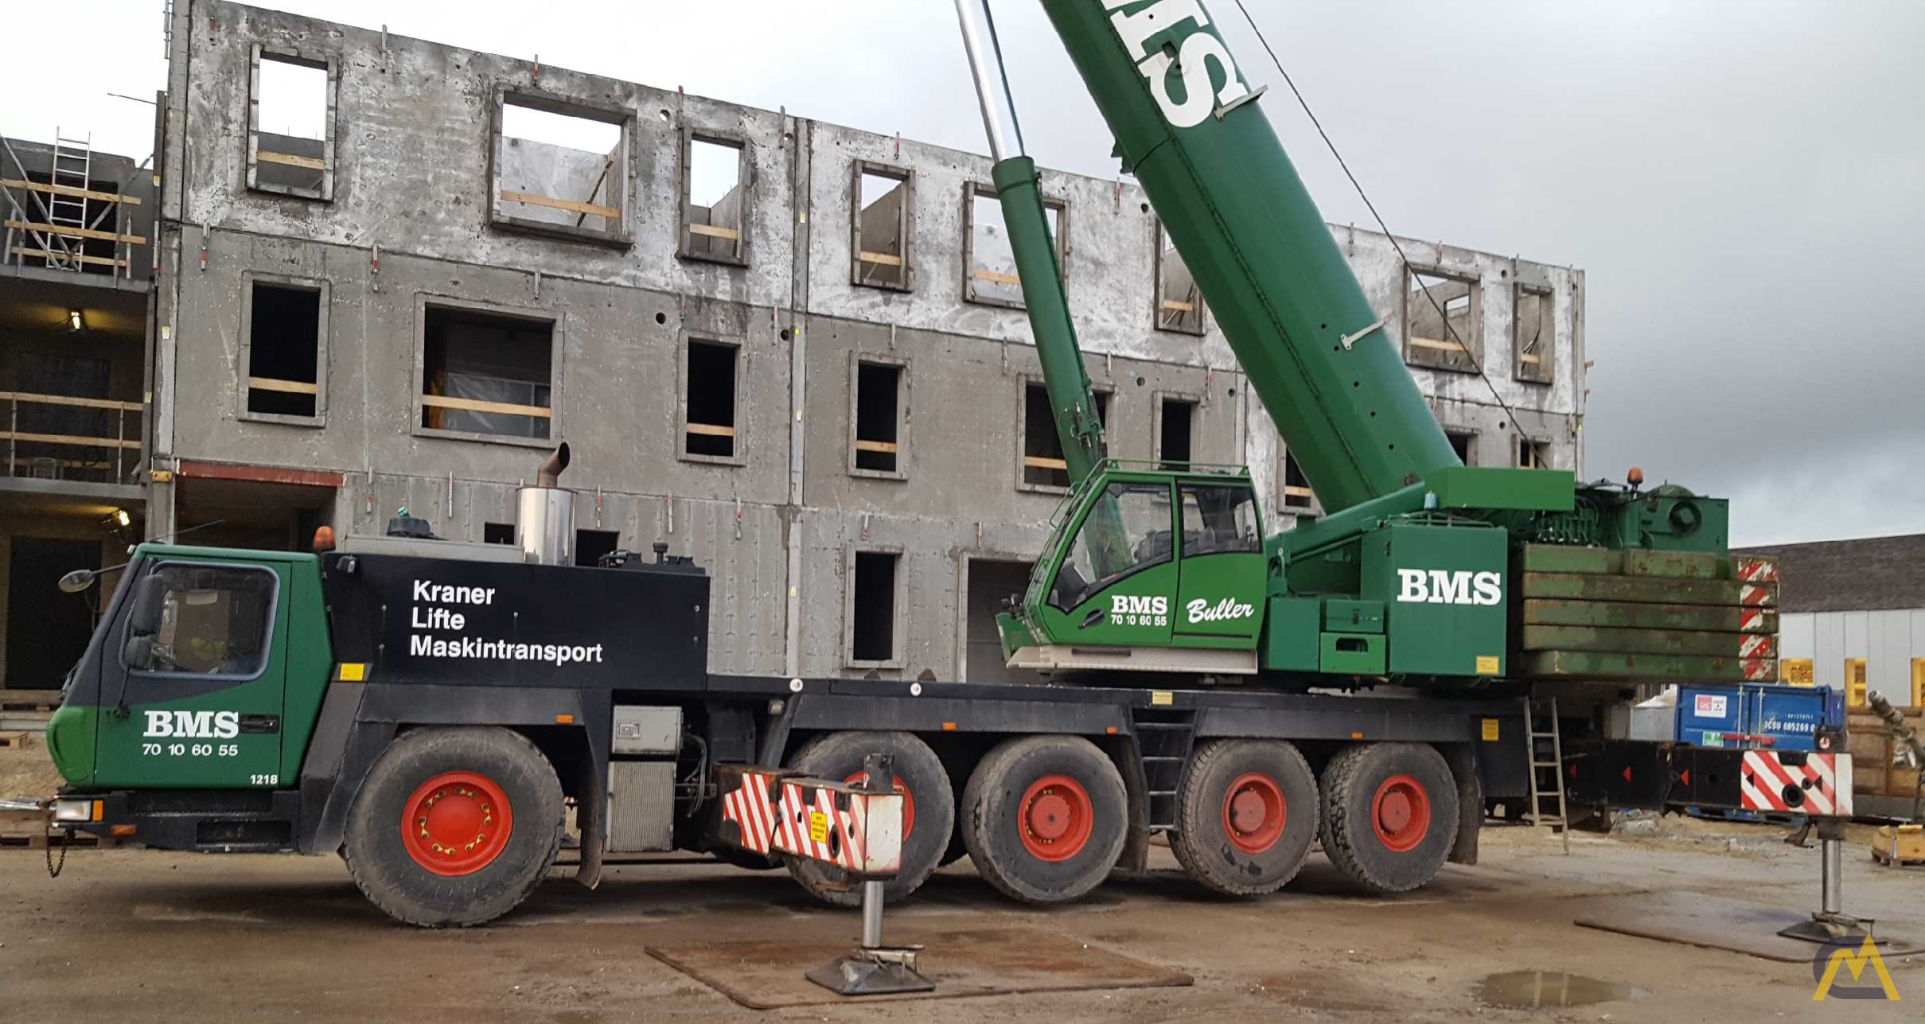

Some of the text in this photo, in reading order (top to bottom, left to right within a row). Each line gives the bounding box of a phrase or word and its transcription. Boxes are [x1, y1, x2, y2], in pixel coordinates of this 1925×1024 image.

[413, 579, 496, 605] Kraner
[1397, 568, 1502, 606] BMS
[1111, 595, 1168, 615] BMS
[1186, 597, 1254, 624] Buller
[412, 606, 465, 630] Lifte
[1111, 614, 1167, 626] 70 10 60 55
[410, 634, 603, 667] Maskintransport
[143, 710, 239, 739] BMS
[142, 744, 239, 756] 70 10 60 55
[250, 774, 278, 785] 1218
